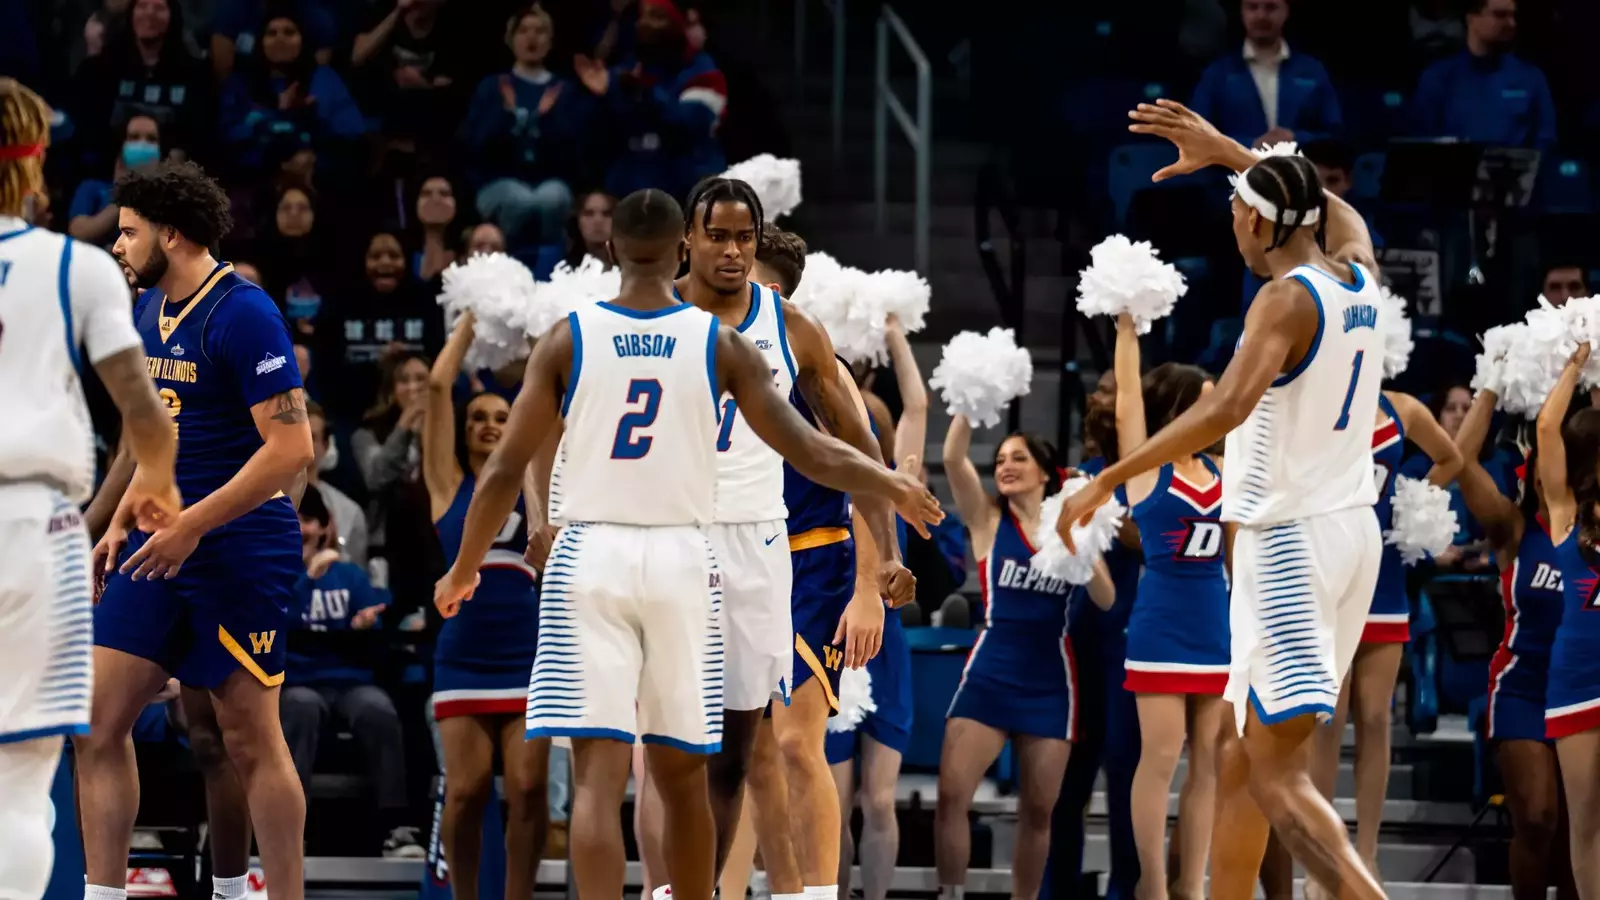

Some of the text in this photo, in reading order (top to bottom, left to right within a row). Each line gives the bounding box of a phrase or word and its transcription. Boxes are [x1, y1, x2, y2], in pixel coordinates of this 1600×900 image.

[612, 334, 677, 359] GIBSON
[161, 358, 197, 383] ILLINOIS
[256, 355, 287, 375] SUMMIT
[1333, 349, 1364, 431] 1
[610, 378, 664, 460] 2
[716, 398, 738, 452] 1
[1184, 522, 1221, 557] D
[1530, 563, 1564, 592] DE
[248, 629, 277, 655] W
[822, 645, 843, 672] W
